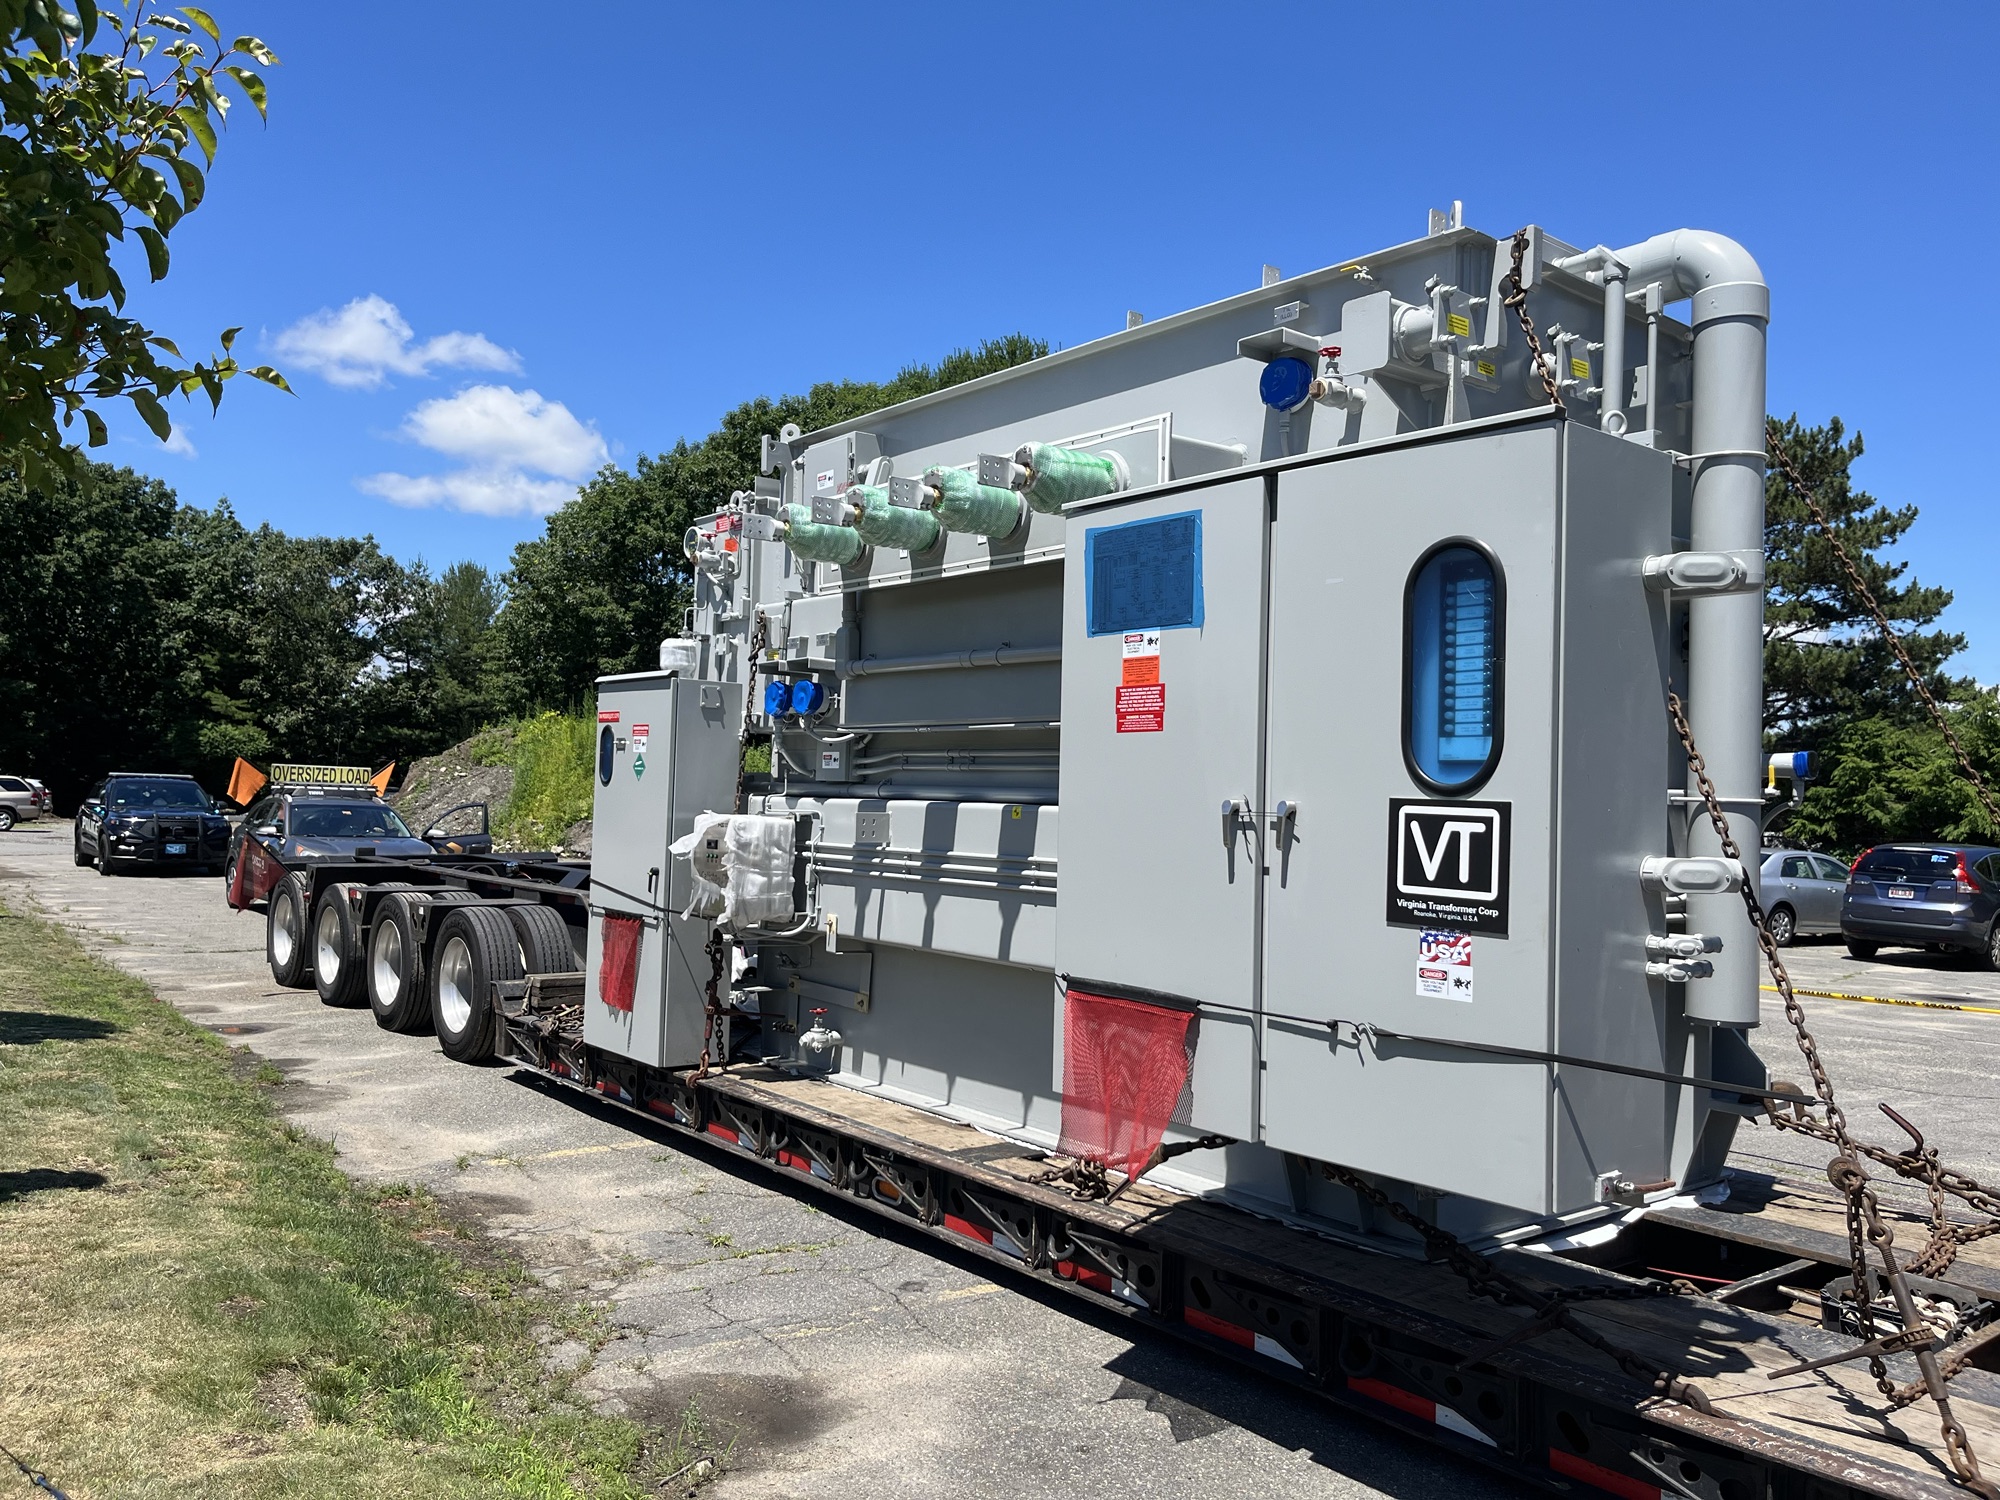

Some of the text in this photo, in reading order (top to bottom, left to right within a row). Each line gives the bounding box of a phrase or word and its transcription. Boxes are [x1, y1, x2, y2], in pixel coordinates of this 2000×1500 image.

[273, 765, 370, 784] OVERSIZED LOAD
[1410, 820, 1486, 884] VT
[1397, 898, 1499, 918] Virginia Transformer Corp
[1414, 910, 1437, 918] Roanoke,
[1439, 912, 1462, 921] Virginia,
[1422, 942, 1468, 961] USA
[1424, 969, 1443, 978] DANGER
